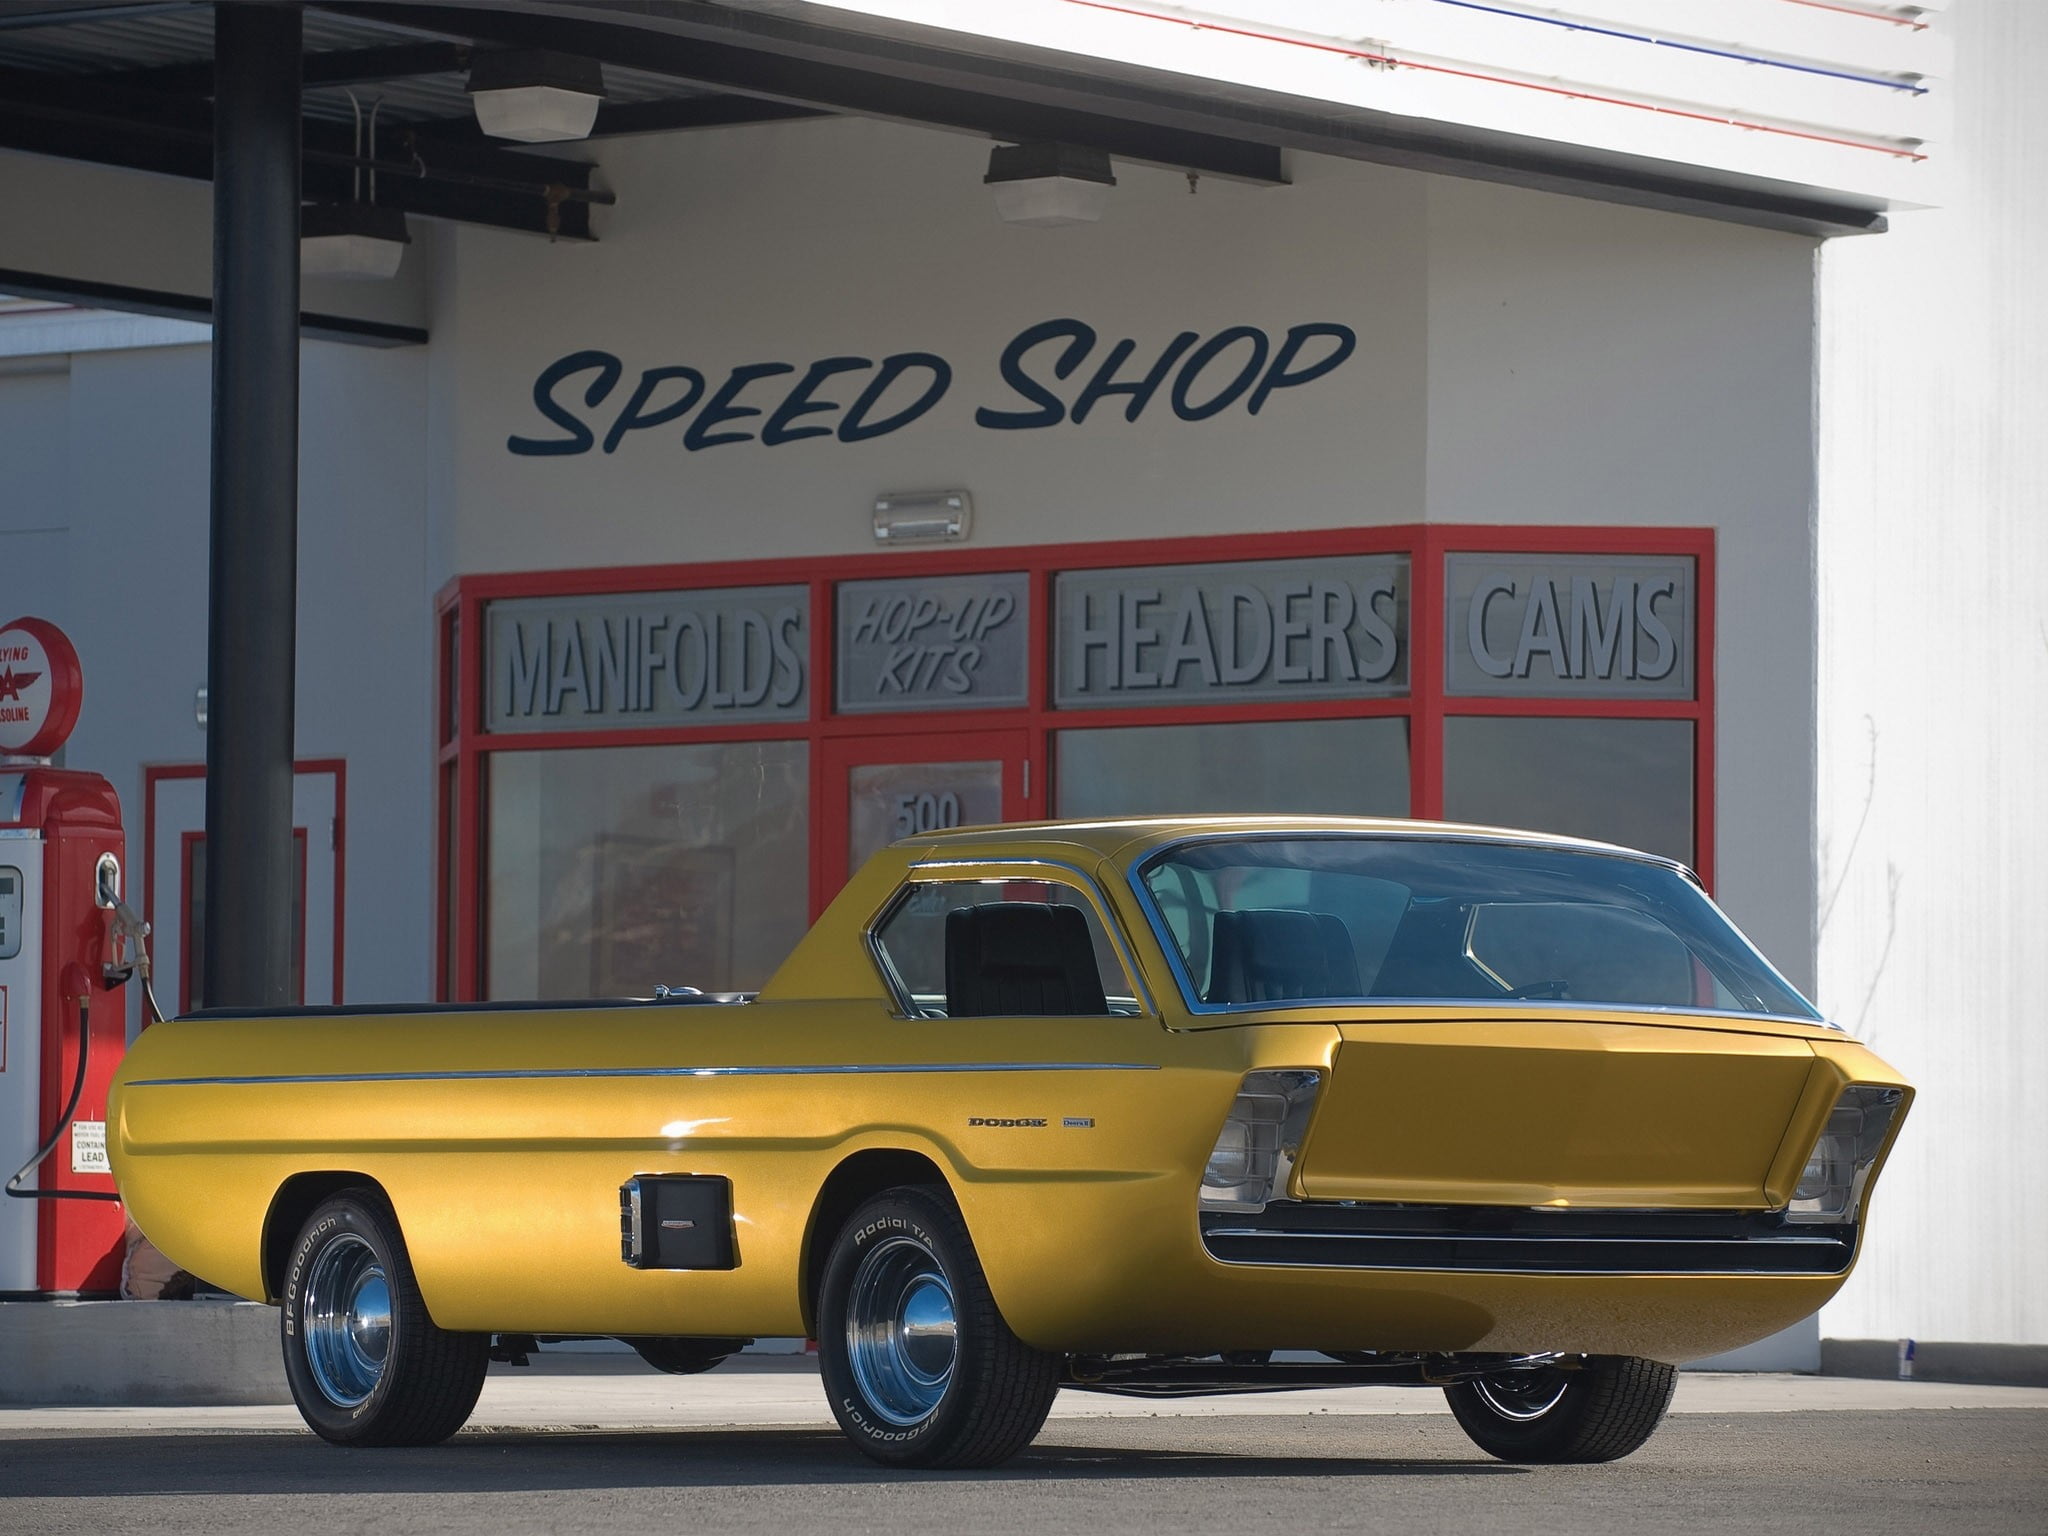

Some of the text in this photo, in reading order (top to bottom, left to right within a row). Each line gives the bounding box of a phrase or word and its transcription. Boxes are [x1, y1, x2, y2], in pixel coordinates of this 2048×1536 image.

[507, 318, 1357, 456] SPEED SHOP
[855, 588, 1016, 645] HOP-UP
[1074, 574, 1398, 692] HEADERS
[1465, 573, 1679, 681] CAMS
[501, 606, 804, 717] MANIFOLDS
[876, 644, 983, 695] KITS
[896, 791, 959, 838] 500
[76, 1140, 105, 1149] CONTAIN
[968, 1117, 1048, 1128] DODGE
[81, 1151, 105, 1162] LEAD
[854, 1216, 907, 1246] Radial
[286, 1216, 337, 1336] BFGoodrich
